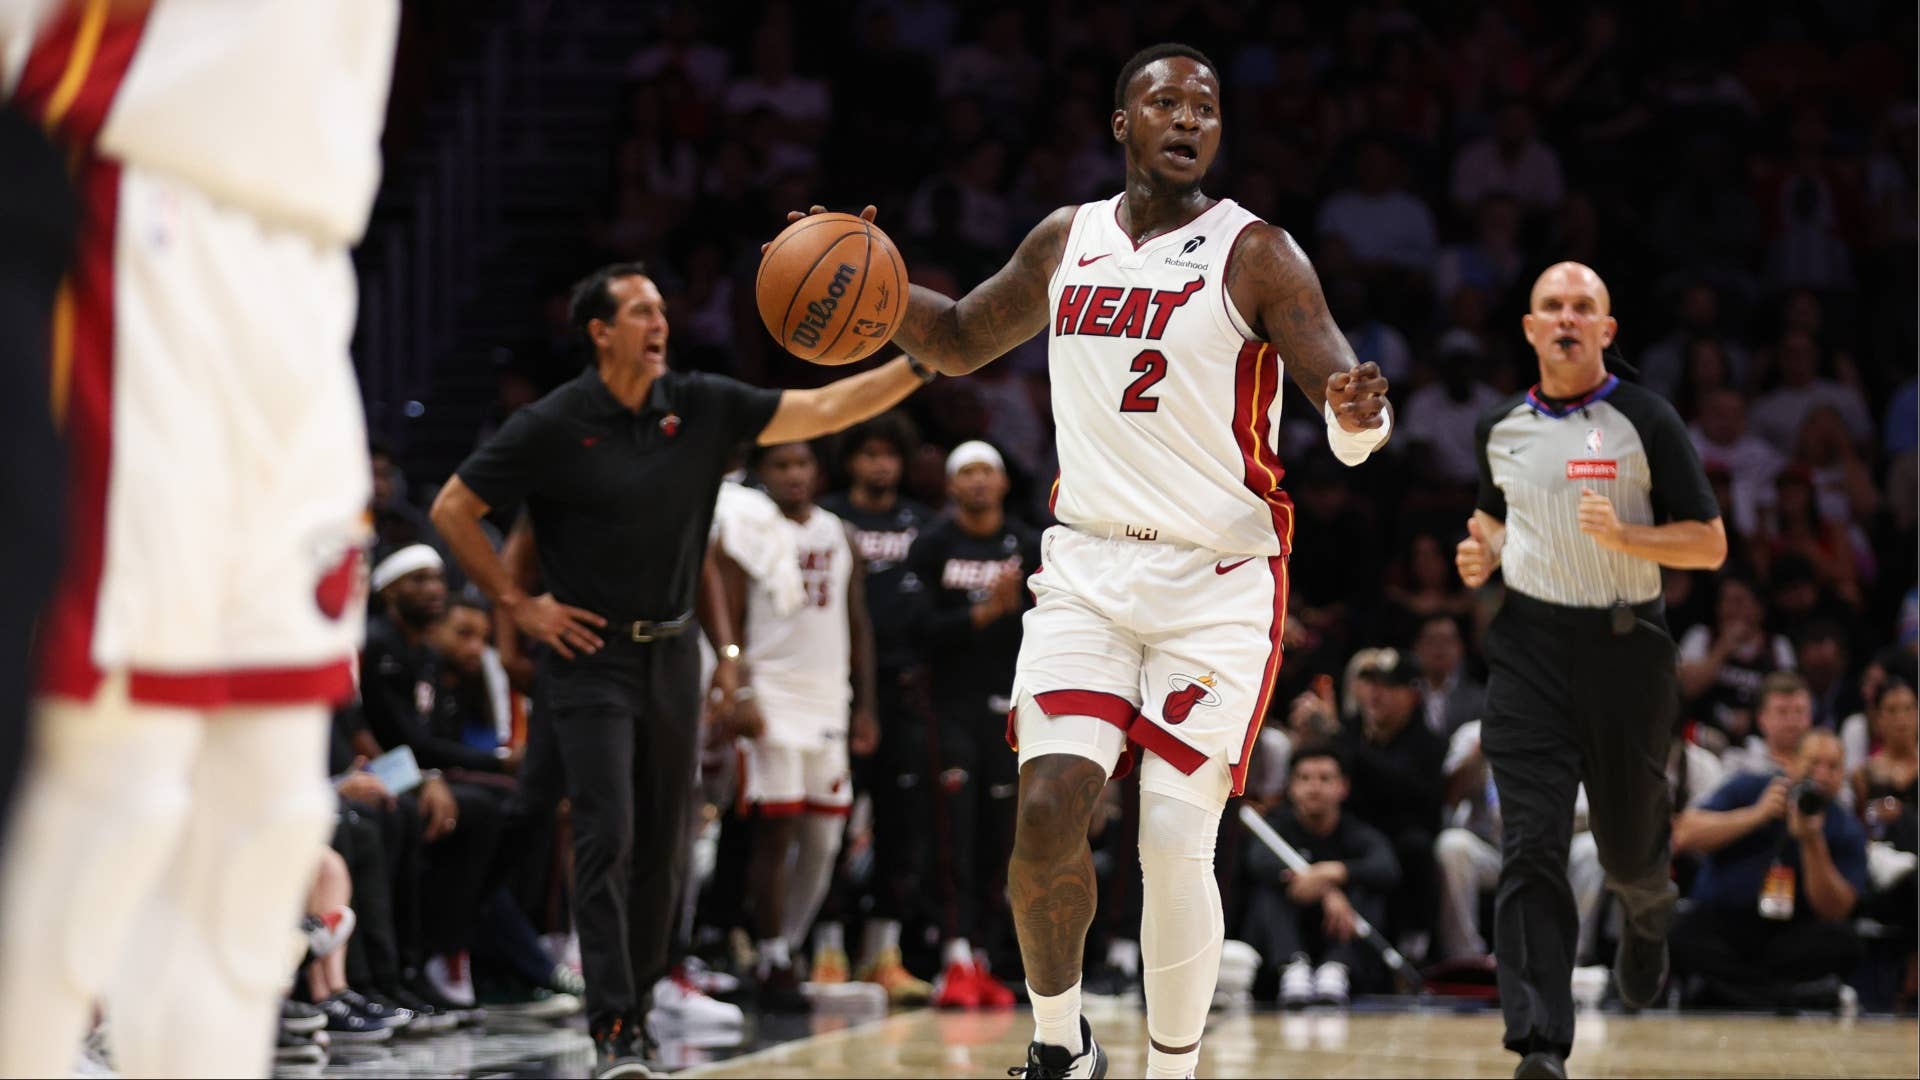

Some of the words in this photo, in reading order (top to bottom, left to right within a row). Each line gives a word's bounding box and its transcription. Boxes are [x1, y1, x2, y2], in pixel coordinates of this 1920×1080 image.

[1164, 256, 1209, 271] Robinhood
[791, 263, 857, 349] Wilson
[1055, 274, 1206, 341] HEAT
[1119, 348, 1169, 413] 2
[1567, 461, 1617, 477] Emirates
